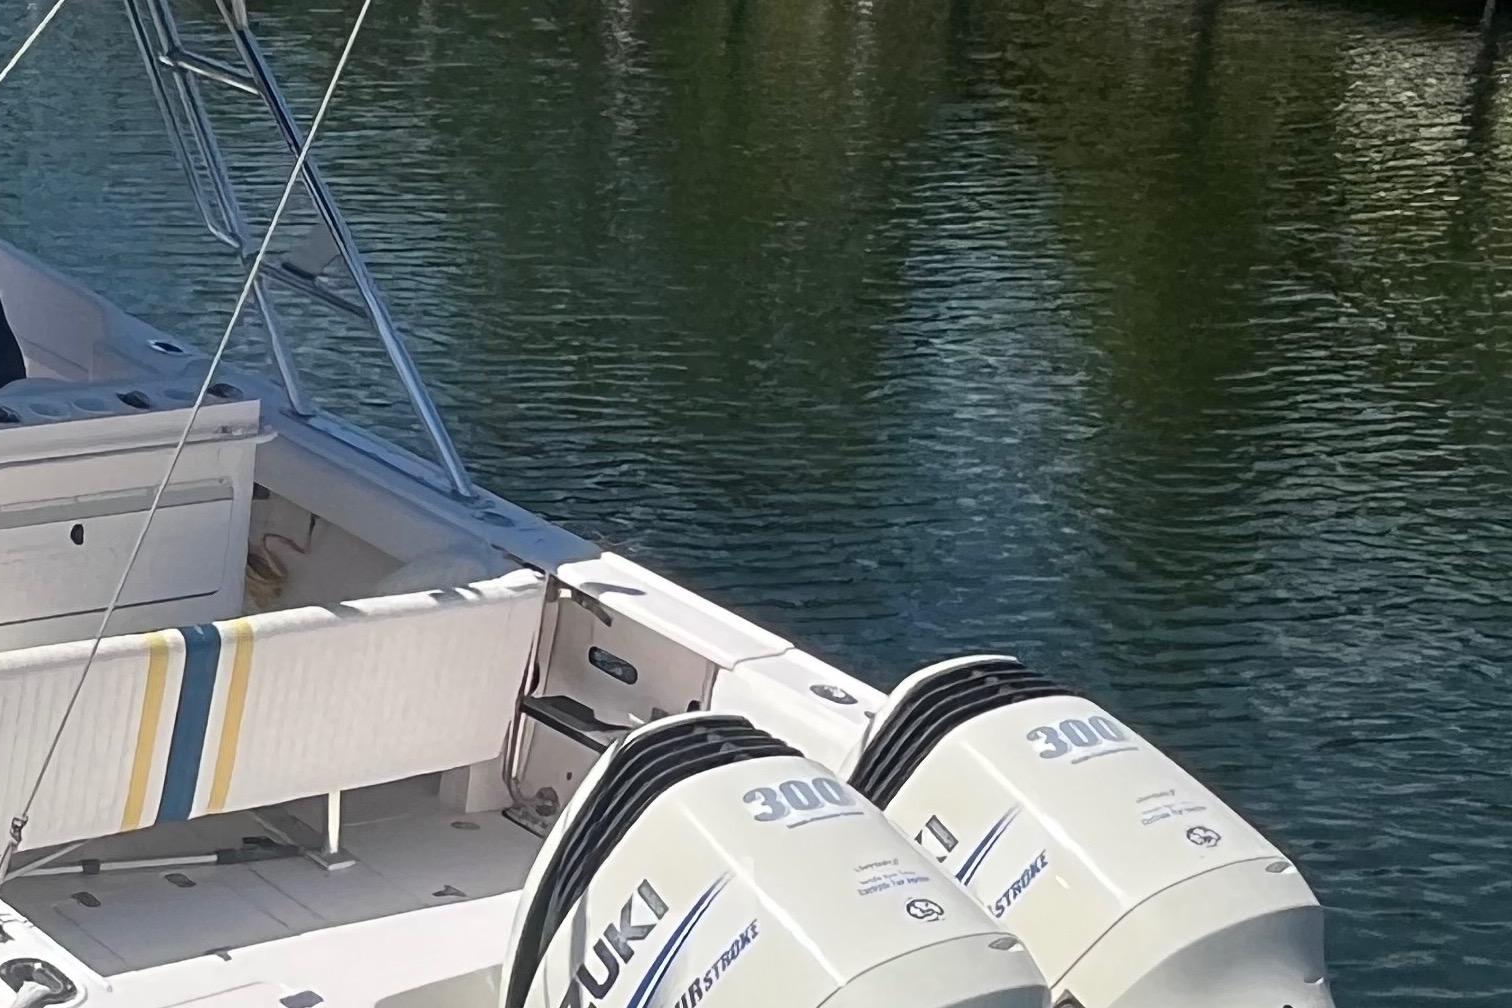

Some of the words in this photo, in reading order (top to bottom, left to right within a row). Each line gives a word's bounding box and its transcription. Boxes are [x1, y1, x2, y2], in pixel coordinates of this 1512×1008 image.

[1026, 715, 1126, 760] 300
[742, 777, 857, 822] 300
[988, 848, 1049, 909] STROKE
